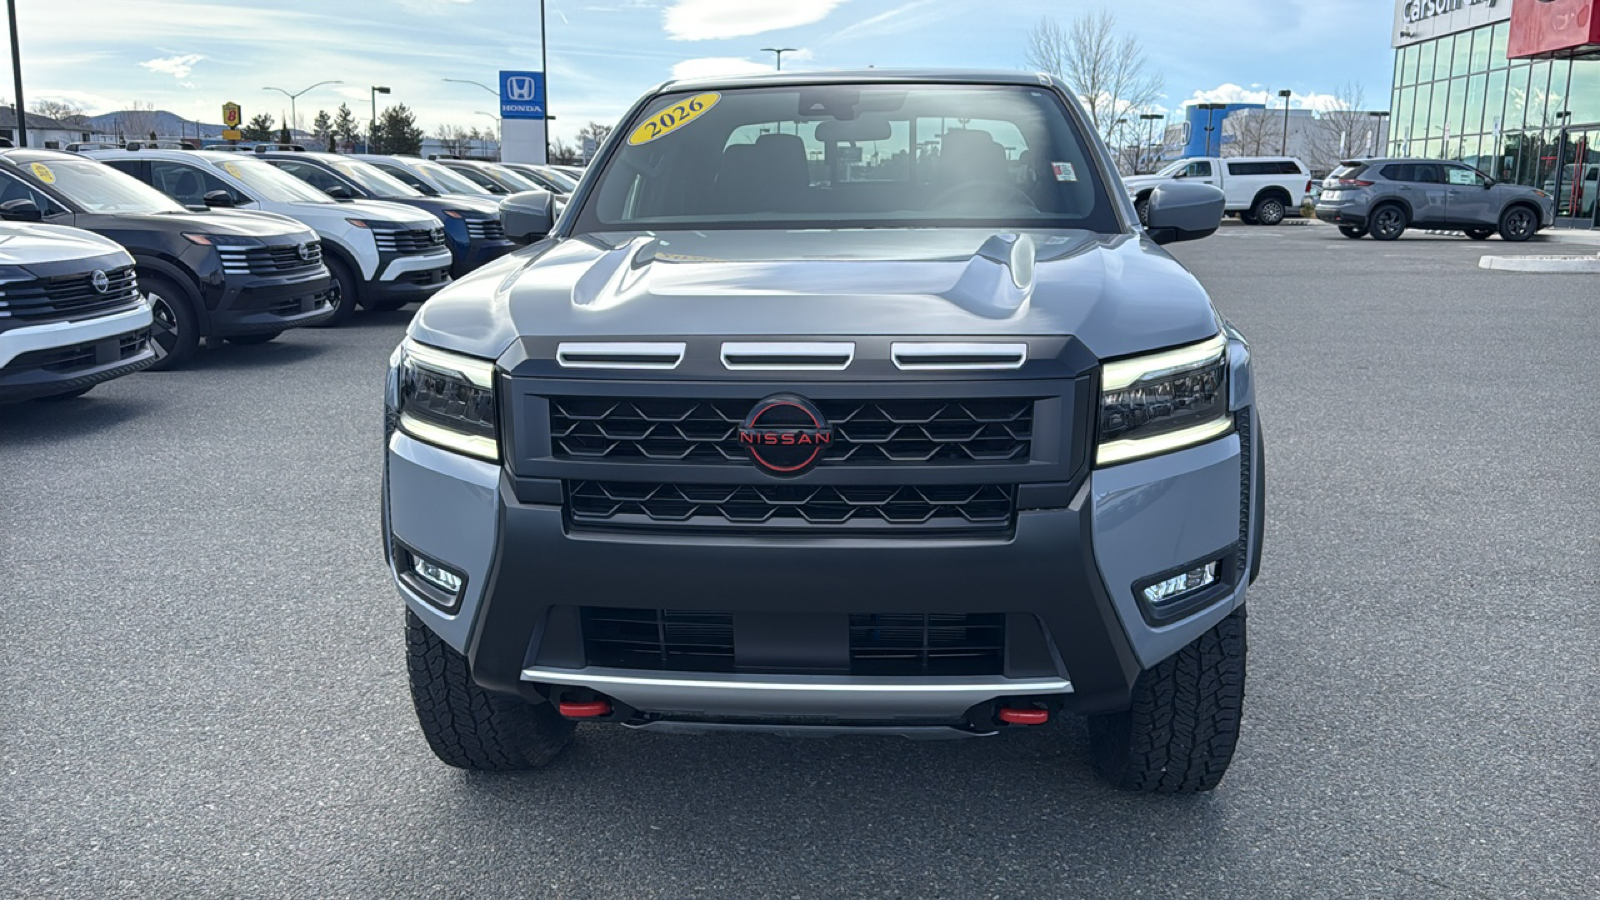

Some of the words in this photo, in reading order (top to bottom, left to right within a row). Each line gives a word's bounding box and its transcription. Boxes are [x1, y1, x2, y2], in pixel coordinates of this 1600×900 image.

[502, 104, 543, 112] HONDA
[227, 109, 236, 121] 8
[644, 97, 704, 138] 2026
[740, 431, 830, 445] NISSAN
